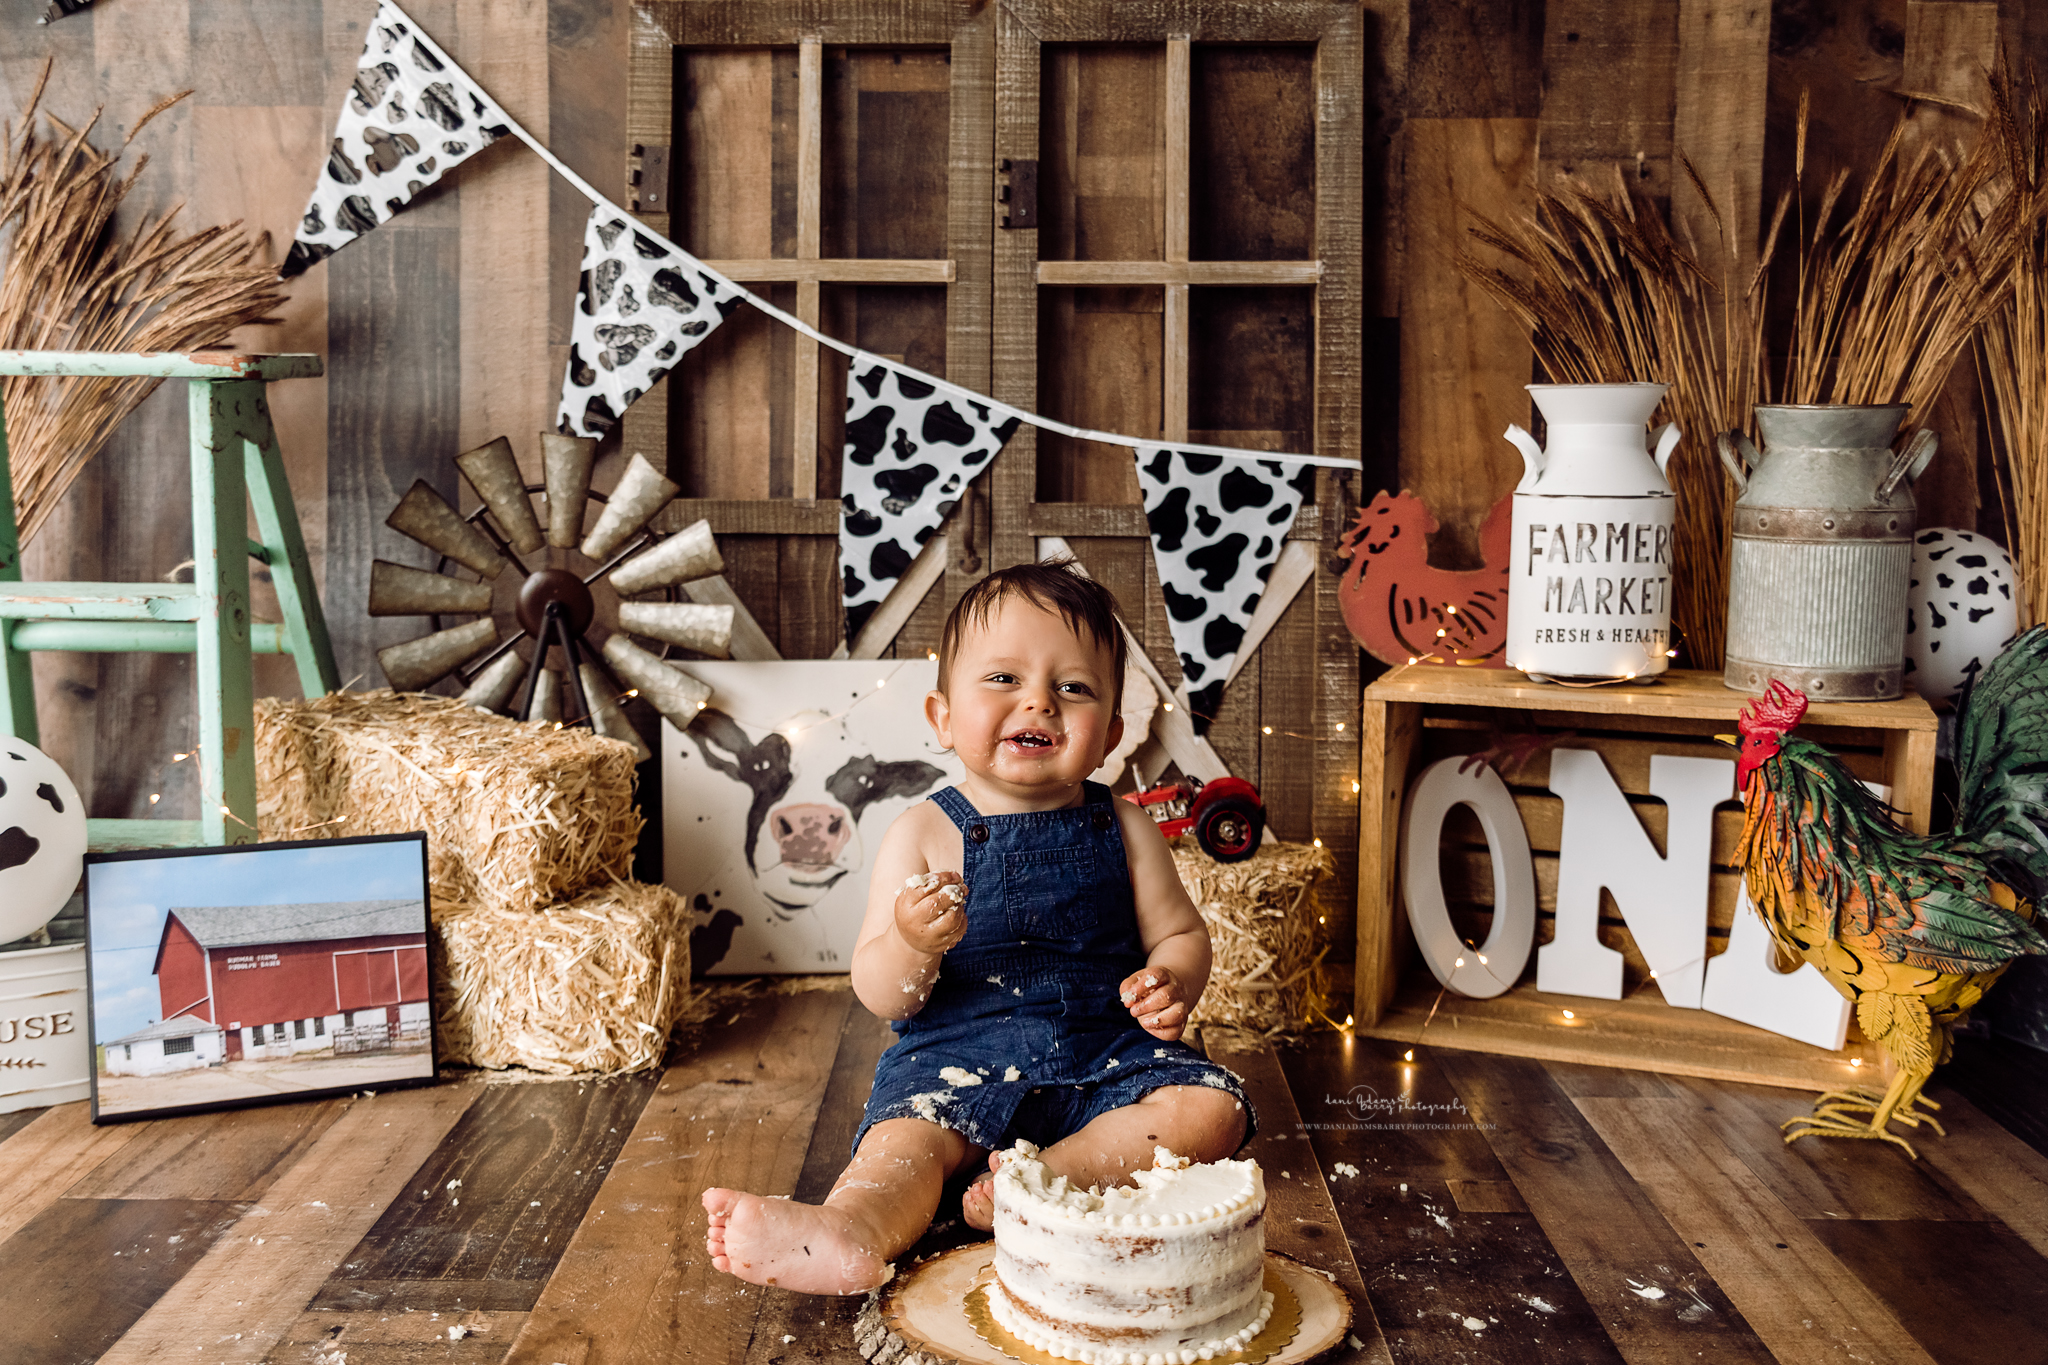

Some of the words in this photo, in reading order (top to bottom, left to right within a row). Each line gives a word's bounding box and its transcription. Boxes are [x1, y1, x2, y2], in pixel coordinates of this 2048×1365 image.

[1544, 576, 1668, 615] MARKET
[1535, 628, 1590, 643] FRESH
[1596, 630, 1605, 641] &
